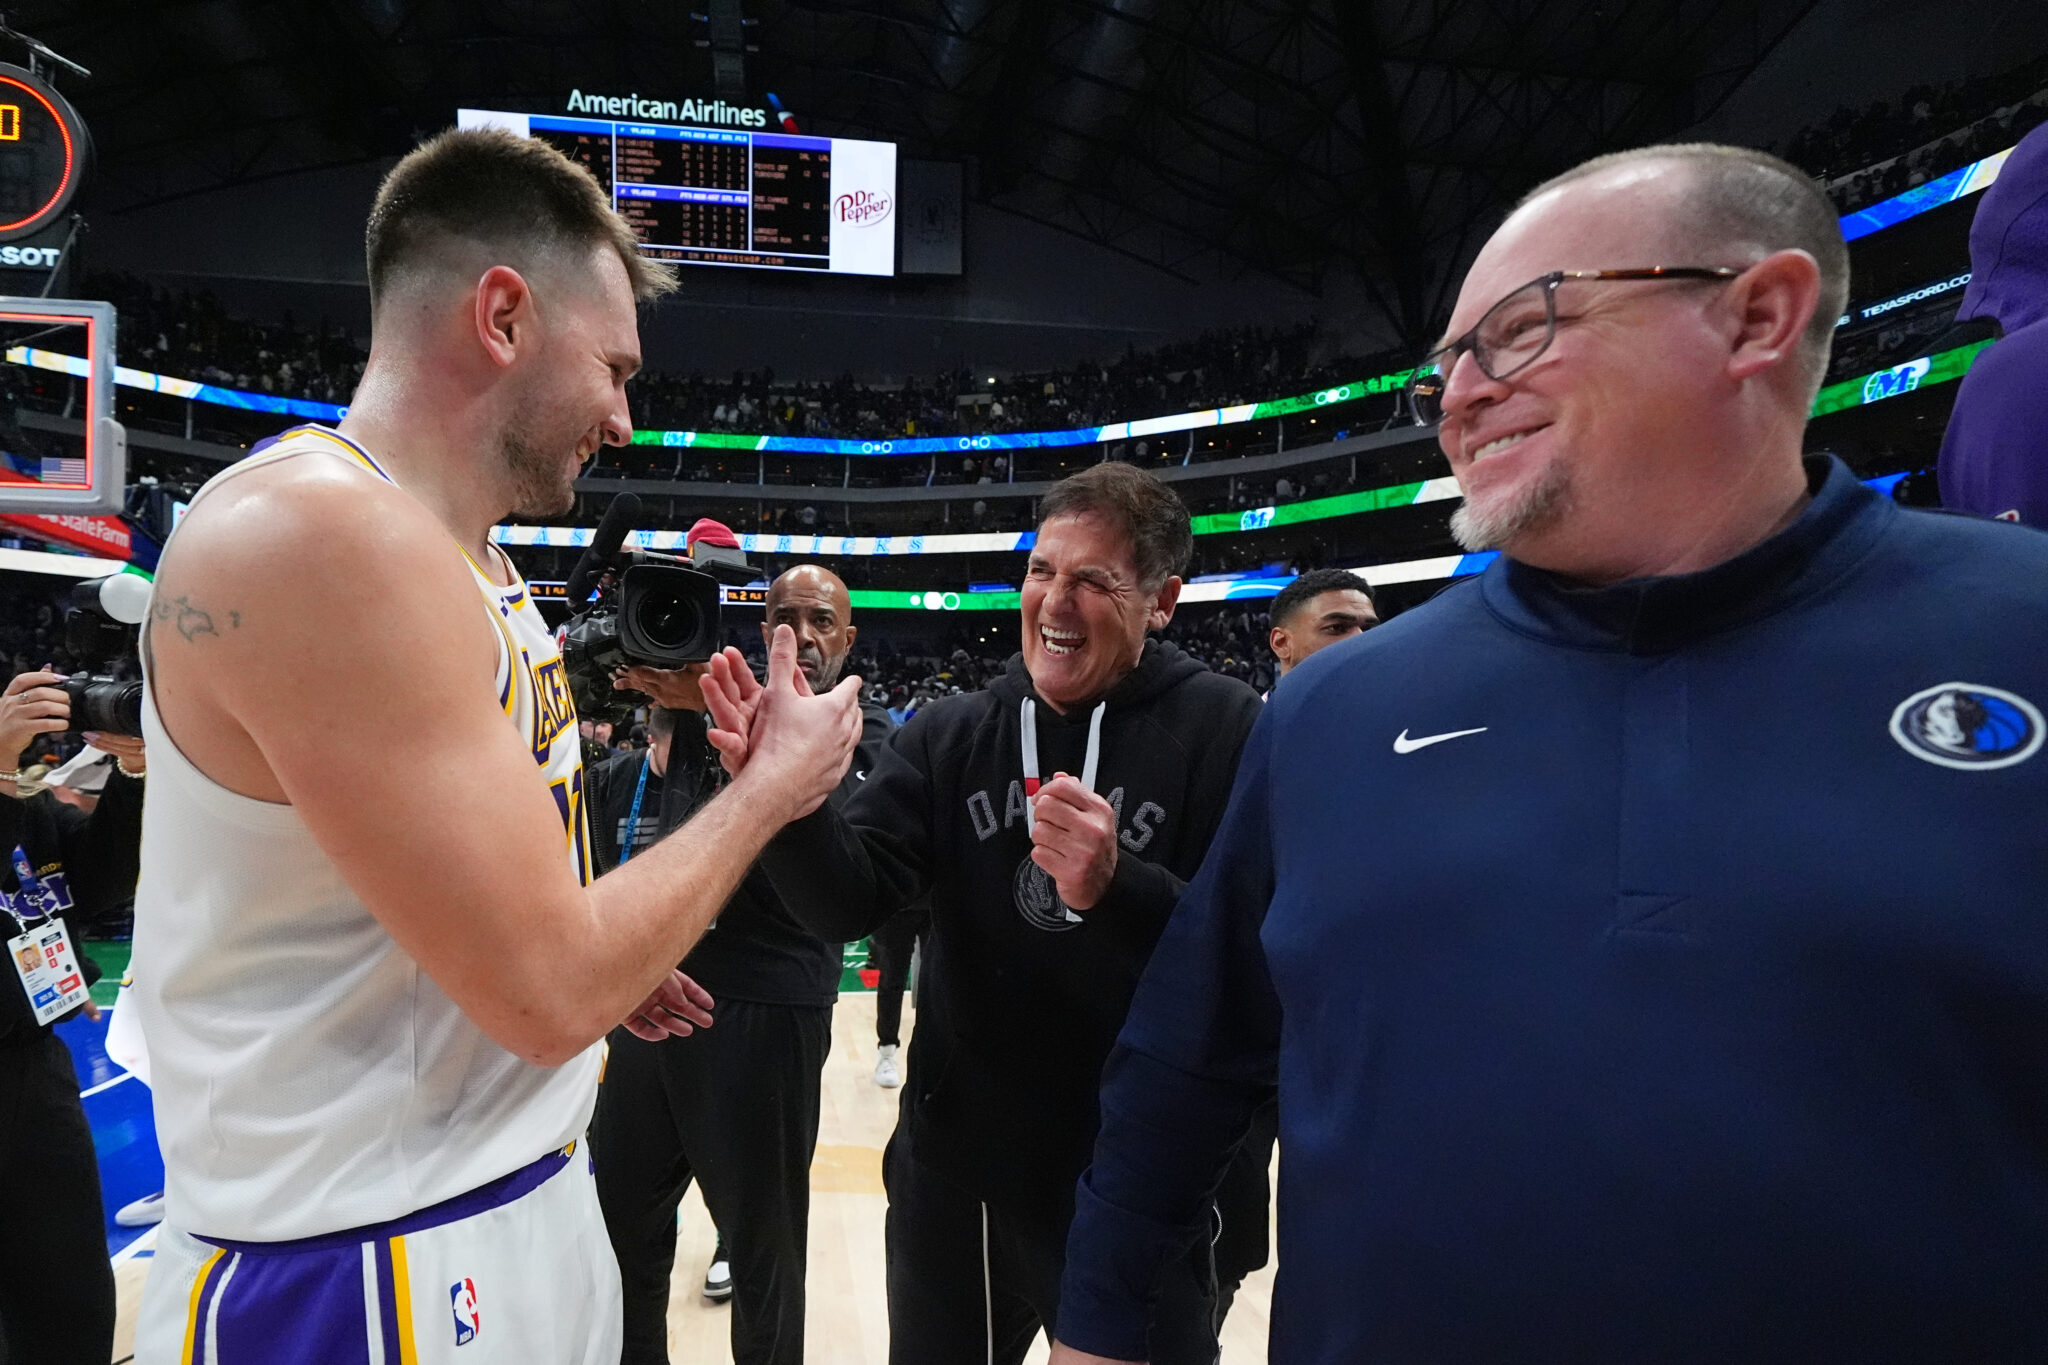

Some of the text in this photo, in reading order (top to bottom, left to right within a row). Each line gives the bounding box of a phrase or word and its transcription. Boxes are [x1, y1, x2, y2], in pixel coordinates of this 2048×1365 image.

[567, 88, 767, 127] American Airlines
[836, 194, 888, 223] Pepper
[855, 190, 874, 207] Dr
[1861, 273, 1971, 318] TEXASFORD.CO
[496, 526, 924, 554] LAS MAERICKS
[739, 590, 747, 601] 2
[521, 646, 578, 768] LAKE
[966, 779, 1167, 852] DAAS
